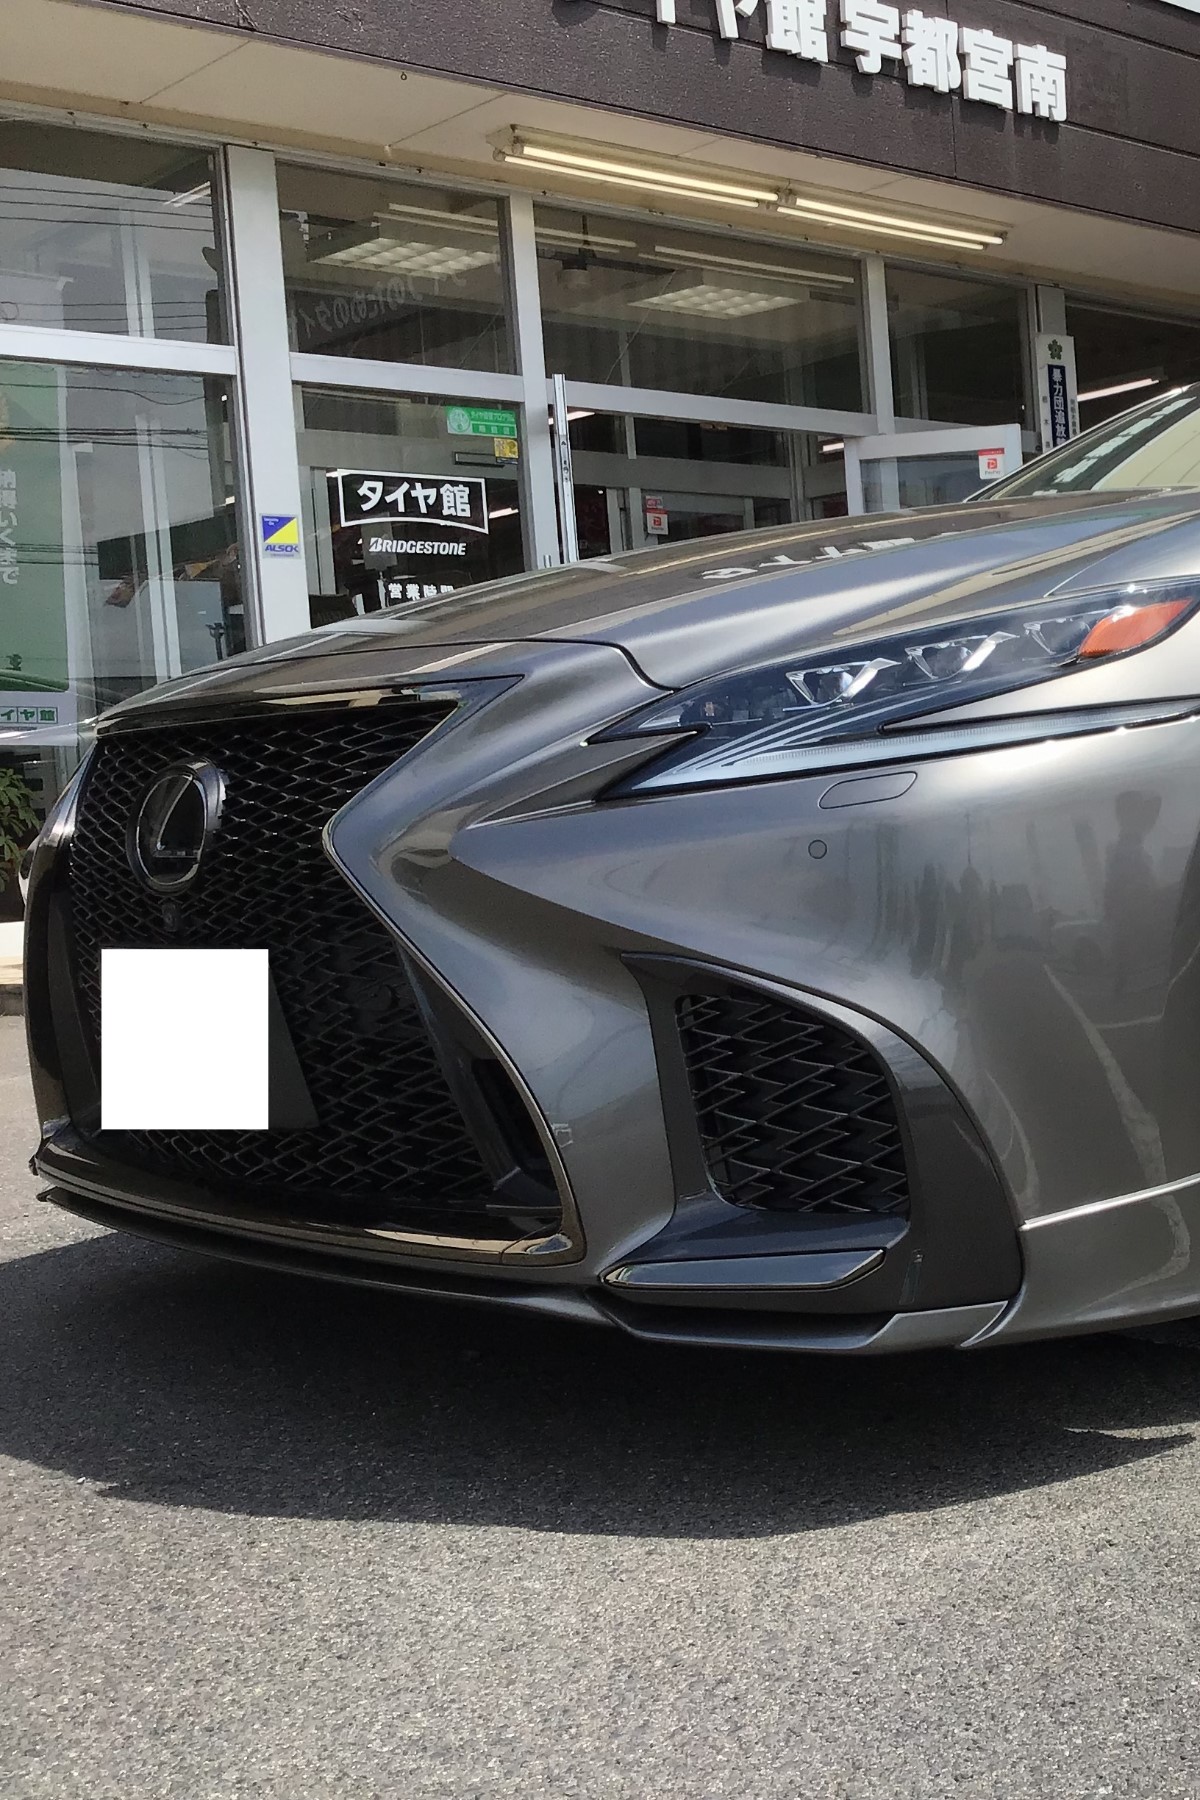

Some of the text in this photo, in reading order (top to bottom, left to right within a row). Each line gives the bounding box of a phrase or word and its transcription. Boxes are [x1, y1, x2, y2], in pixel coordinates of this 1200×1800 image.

[656, 0, 1067, 122] 館宇都宮南
[357, 480, 471, 518] タイヤ館
[264, 544, 299, 553] ALSOK
[368, 537, 467, 556] BRIDGESTONE
